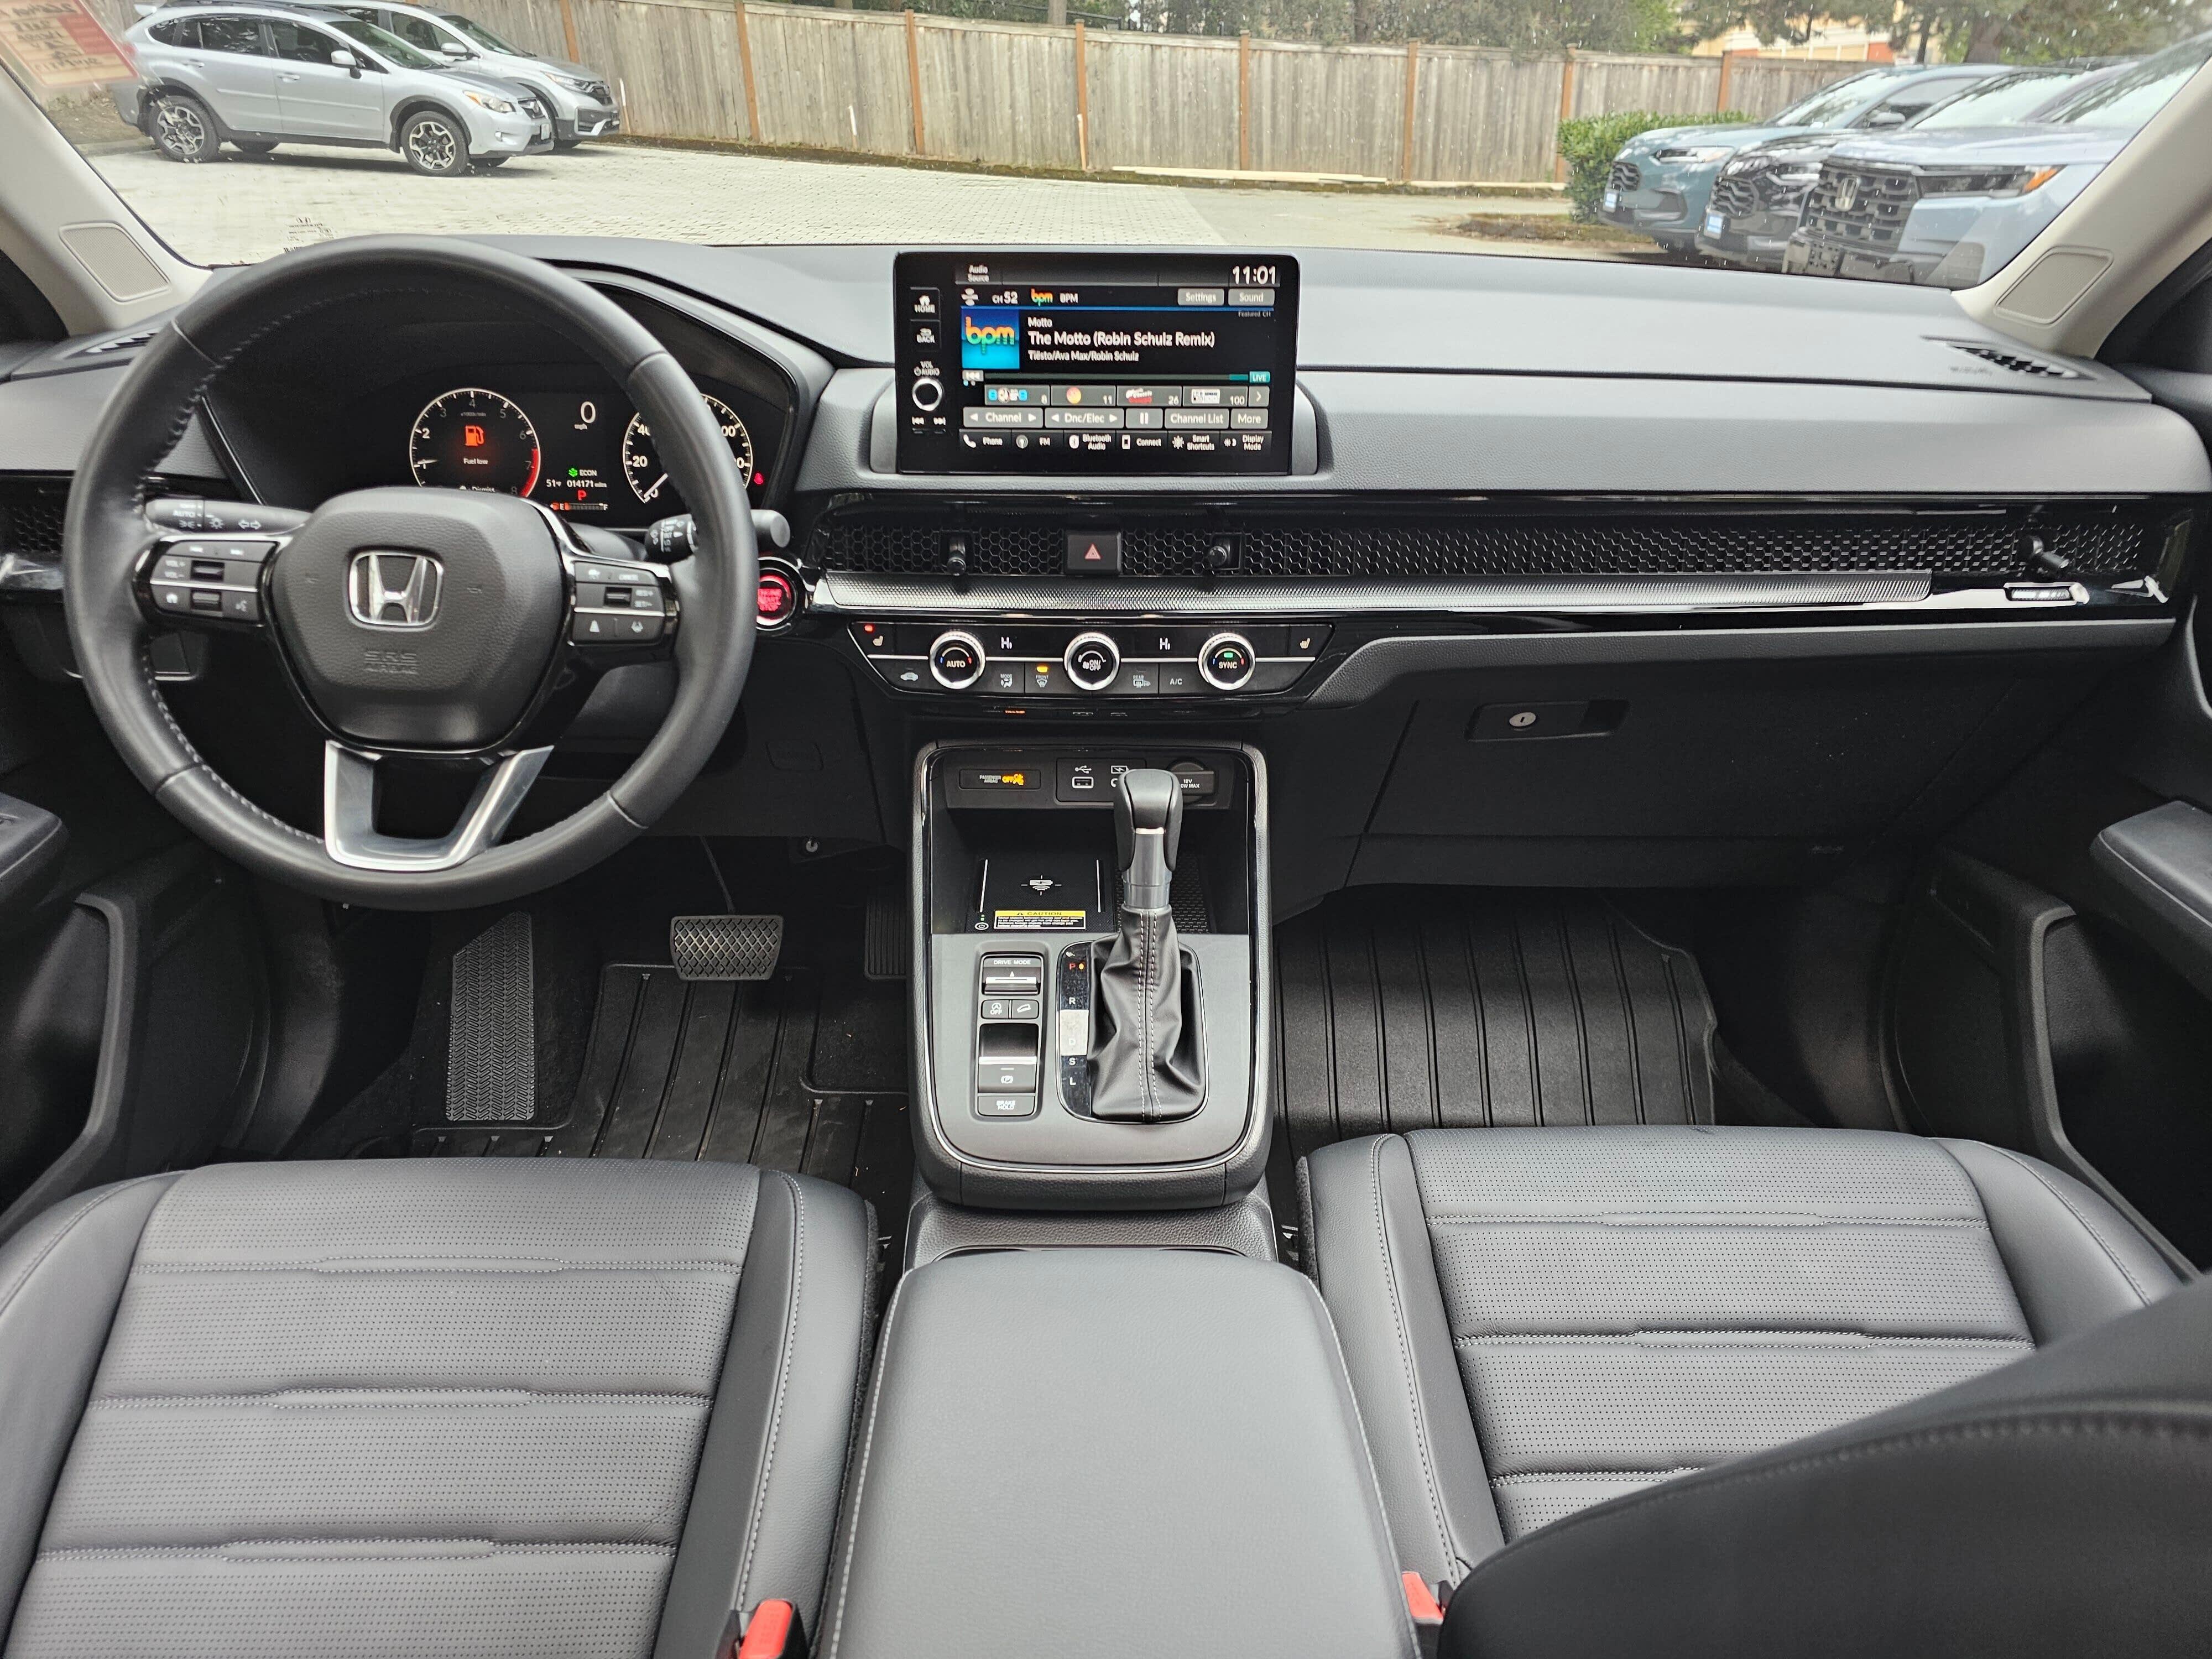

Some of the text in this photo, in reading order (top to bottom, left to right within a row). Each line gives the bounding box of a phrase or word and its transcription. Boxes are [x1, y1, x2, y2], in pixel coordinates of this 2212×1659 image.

[968, 265, 988, 274] Audio
[1232, 265, 1276, 284] 11:01
[968, 274, 989, 282] Source
[1031, 288, 1053, 306] bpm
[1060, 293, 1078, 303] BPM
[1185, 292, 1217, 303] Settings
[1239, 292, 1264, 302] Sound
[914, 305, 936, 313] HOME
[1027, 317, 1053, 327] Motto
[916, 335, 936, 343] BACK
[965, 316, 1015, 355] bpm
[1027, 331, 1215, 348] The Motto (Robin Schulz Remix)
[1071, 351, 1113, 361] Max/Robin
[1114, 351, 1139, 361] Schulz
[921, 368, 940, 376] AUDIO
[469, 399, 476, 409] 4
[1103, 394, 1113, 405] 11
[1168, 395, 1179, 406] 26
[1230, 395, 1245, 406] 100
[440, 408, 447, 418] 3
[499, 409, 507, 419] 5
[580, 400, 596, 424] 0
[985, 412, 1022, 423] Channel
[1064, 413, 1105, 424] Dnc/Elec
[1170, 414, 1224, 424] Channel List
[1238, 414, 1261, 424] More
[422, 427, 431, 439] 2
[519, 430, 526, 440] 6
[1082, 434, 1112, 442] Bluetooth
[1192, 434, 1210, 442] Smart
[983, 437, 1003, 446] Phone
[1039, 437, 1051, 446] FM
[1136, 438, 1161, 446] Connect
[1242, 435, 1264, 444] Display
[1088, 442, 1106, 451] Audio
[1187, 442, 1215, 451] Shortcuts
[1244, 442, 1262, 451] Mode
[632, 455, 648, 467] 20
[577, 489, 587, 500] P
[1218, 661, 1238, 669] SYNC
[1068, 1057, 1076, 1066] S
[1069, 1077, 1077, 1086] L
